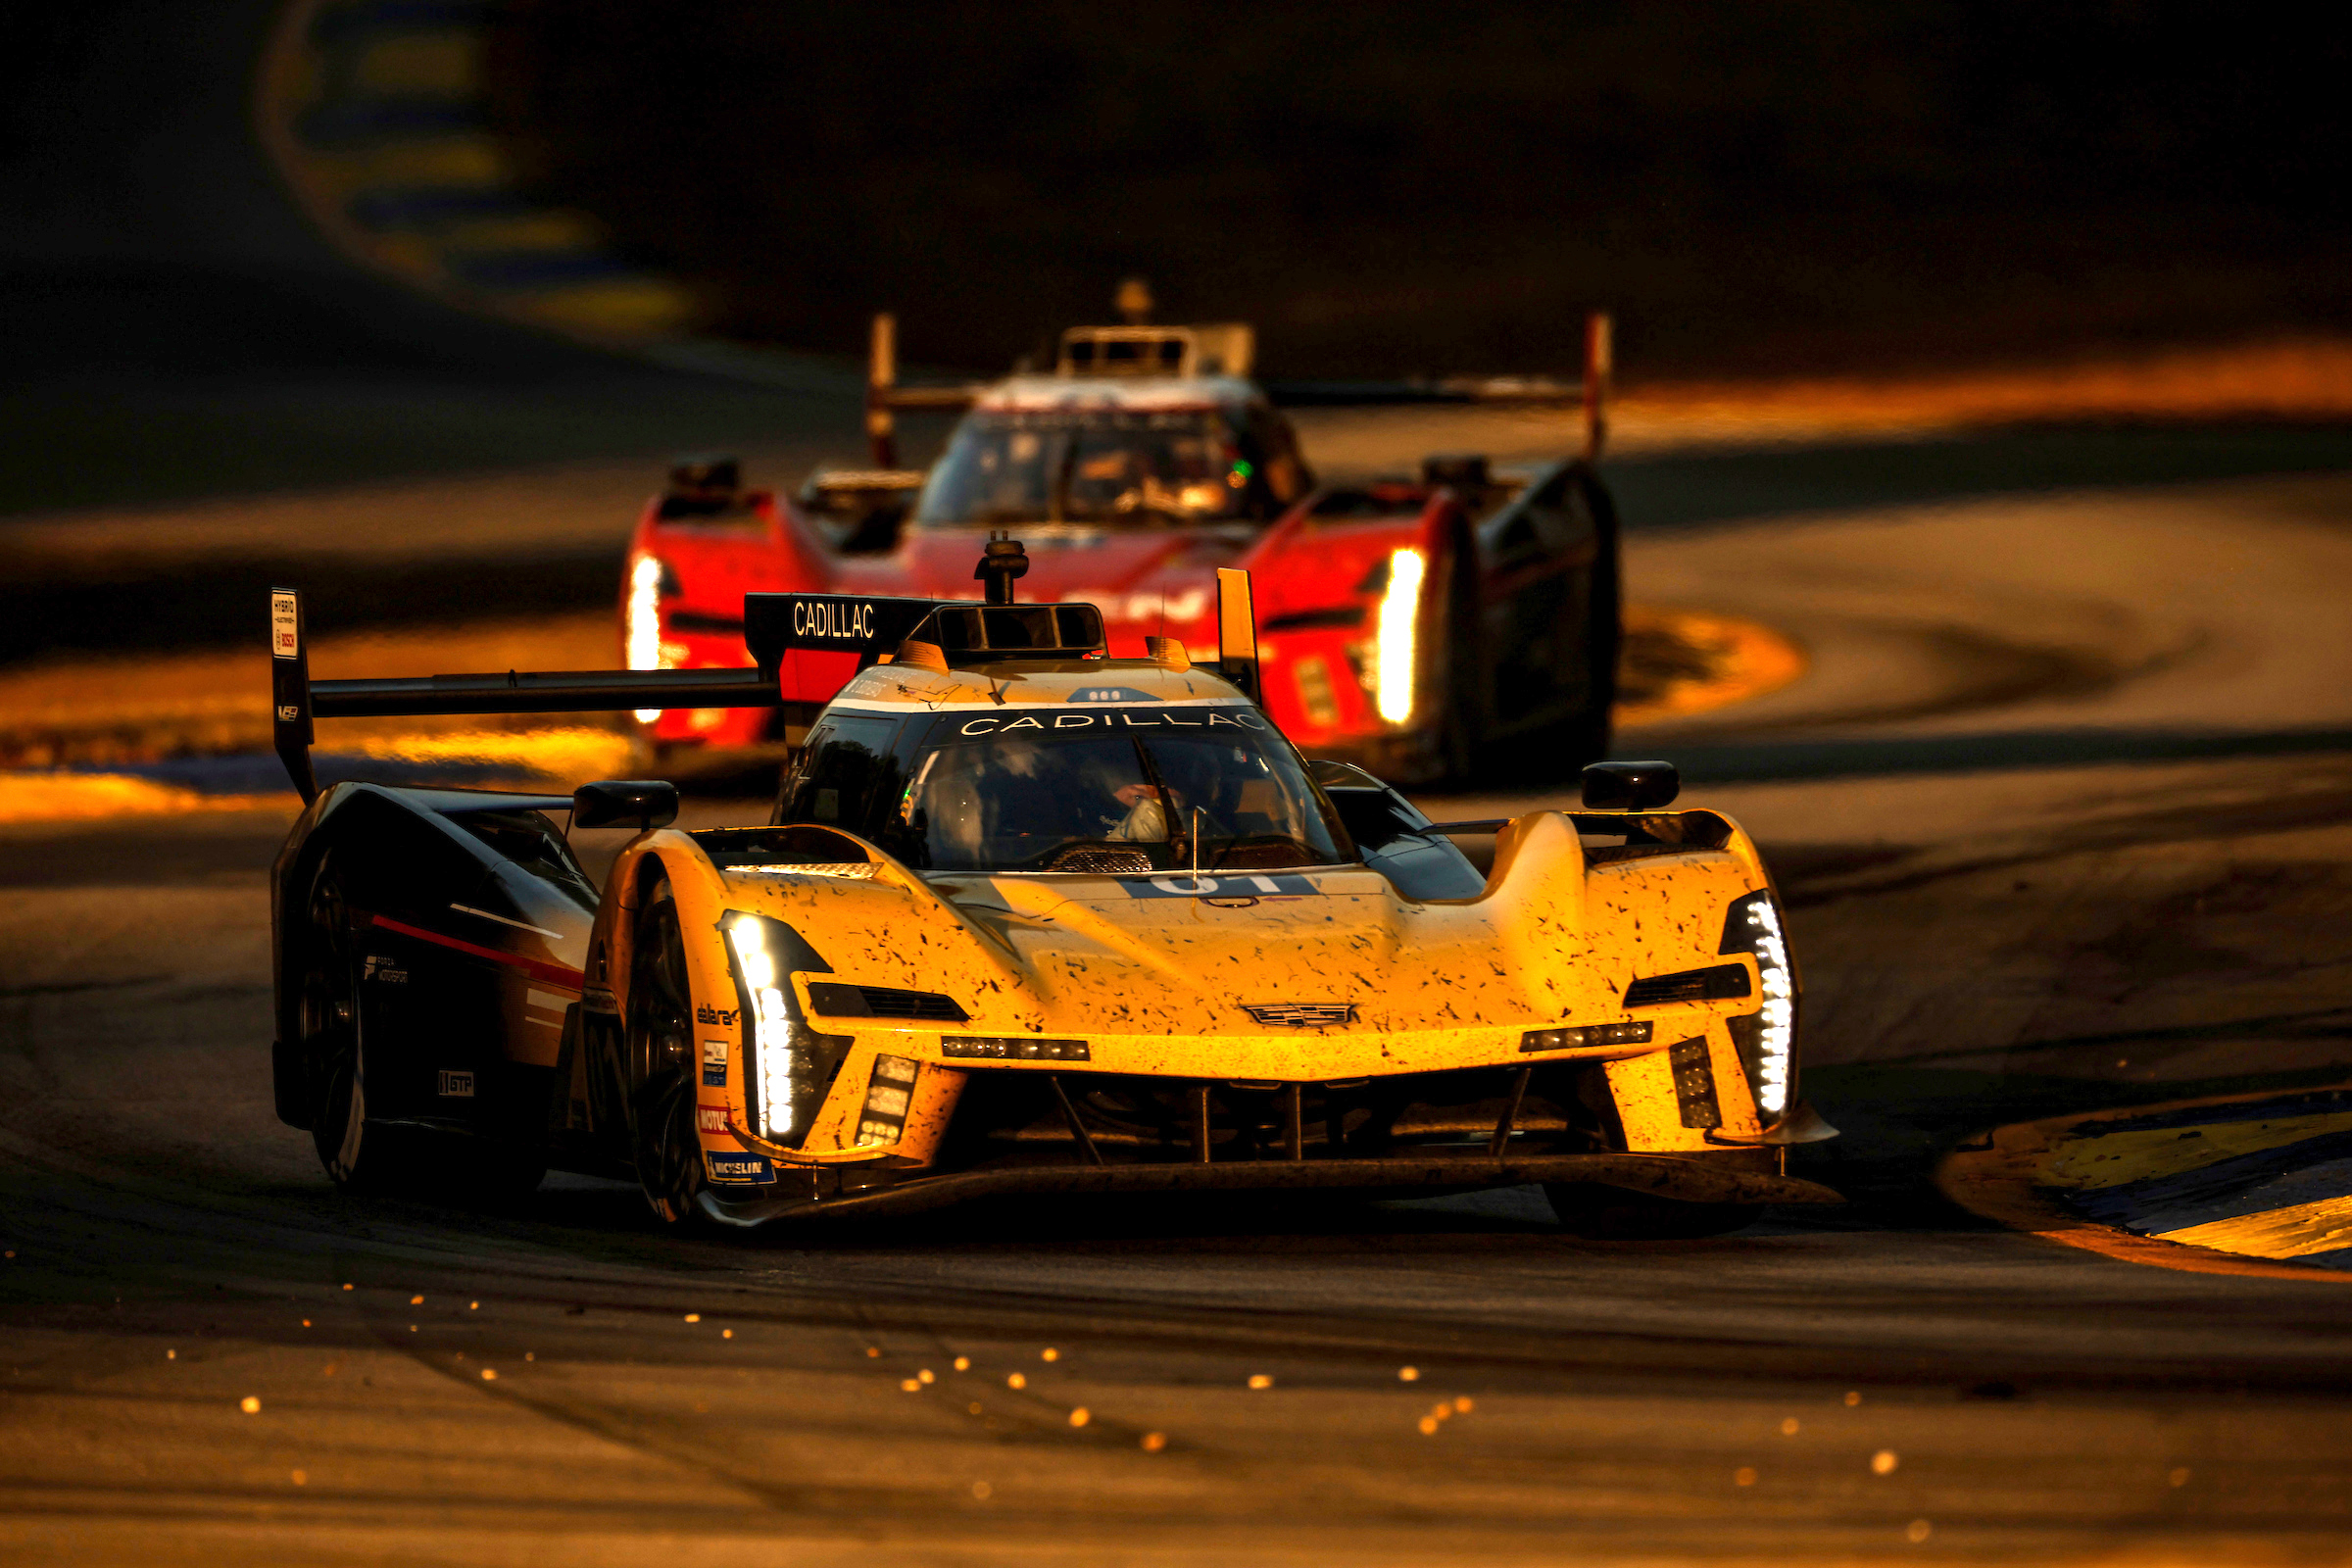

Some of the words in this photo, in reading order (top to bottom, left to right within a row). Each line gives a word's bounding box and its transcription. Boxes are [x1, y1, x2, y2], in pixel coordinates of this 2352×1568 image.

[794, 601, 874, 639] CADILLAC
[960, 709, 1266, 737] CADILLAC
[1150, 875, 1282, 895] 01
[450, 1075, 472, 1093] GTP
